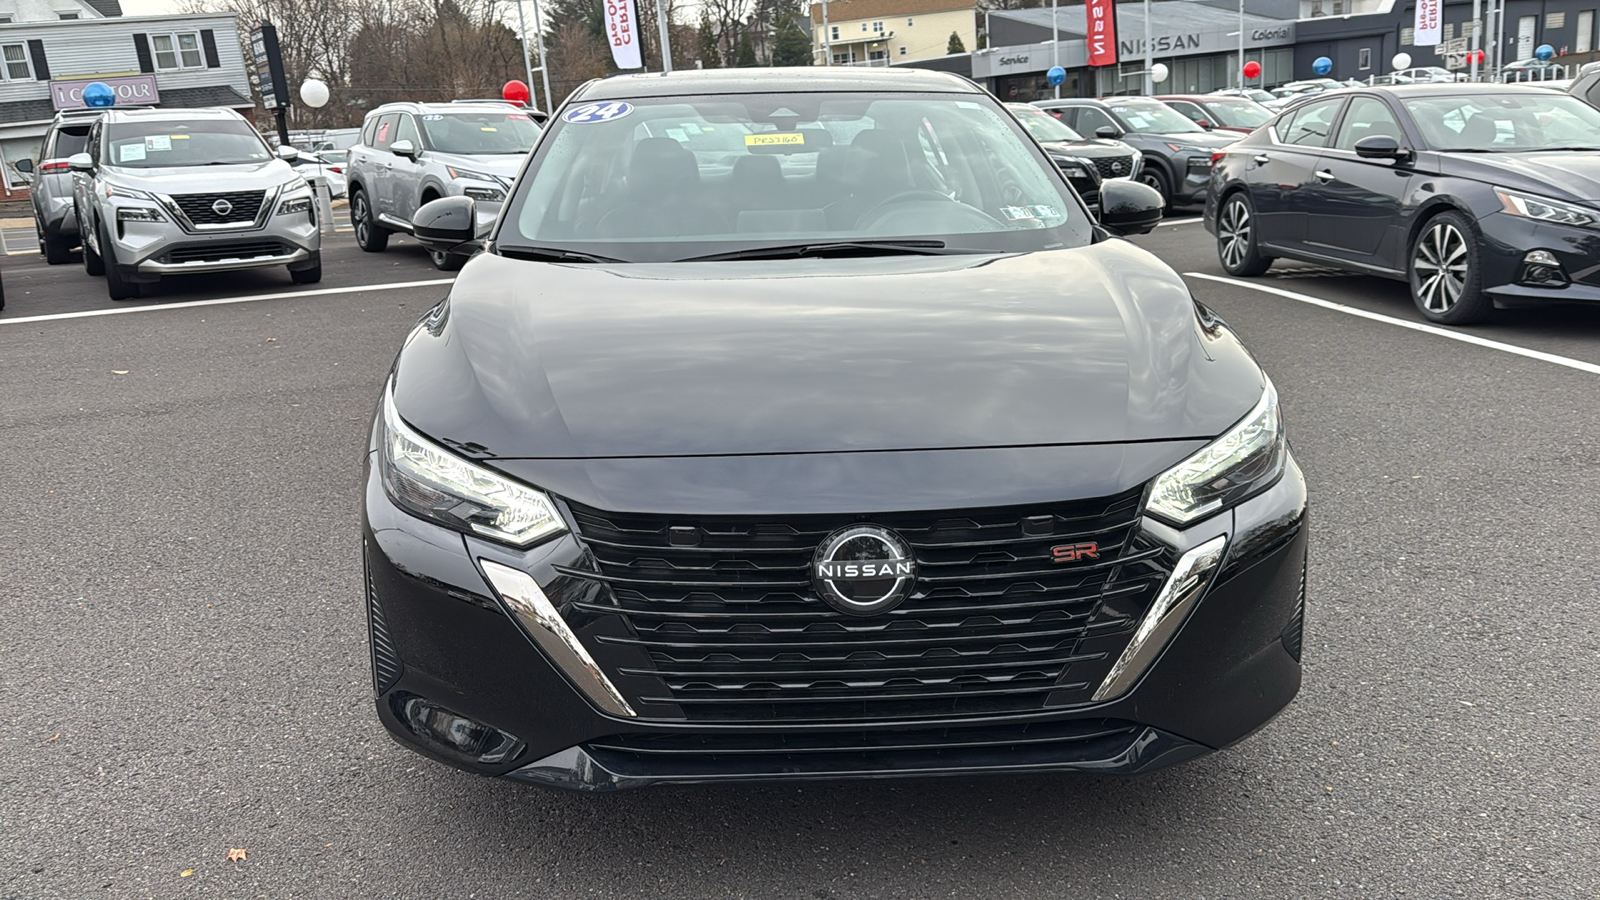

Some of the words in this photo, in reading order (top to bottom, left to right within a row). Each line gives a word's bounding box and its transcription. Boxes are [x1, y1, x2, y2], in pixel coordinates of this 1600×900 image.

[1251, 27, 1290, 41] Colonial
[1120, 34, 1200, 55] NISSAN
[999, 55, 1029, 66] Service
[69, 83, 150, 102] COUR
[570, 103, 624, 122] 24
[1052, 543, 1098, 562] SR
[818, 562, 911, 578] NISSAN
